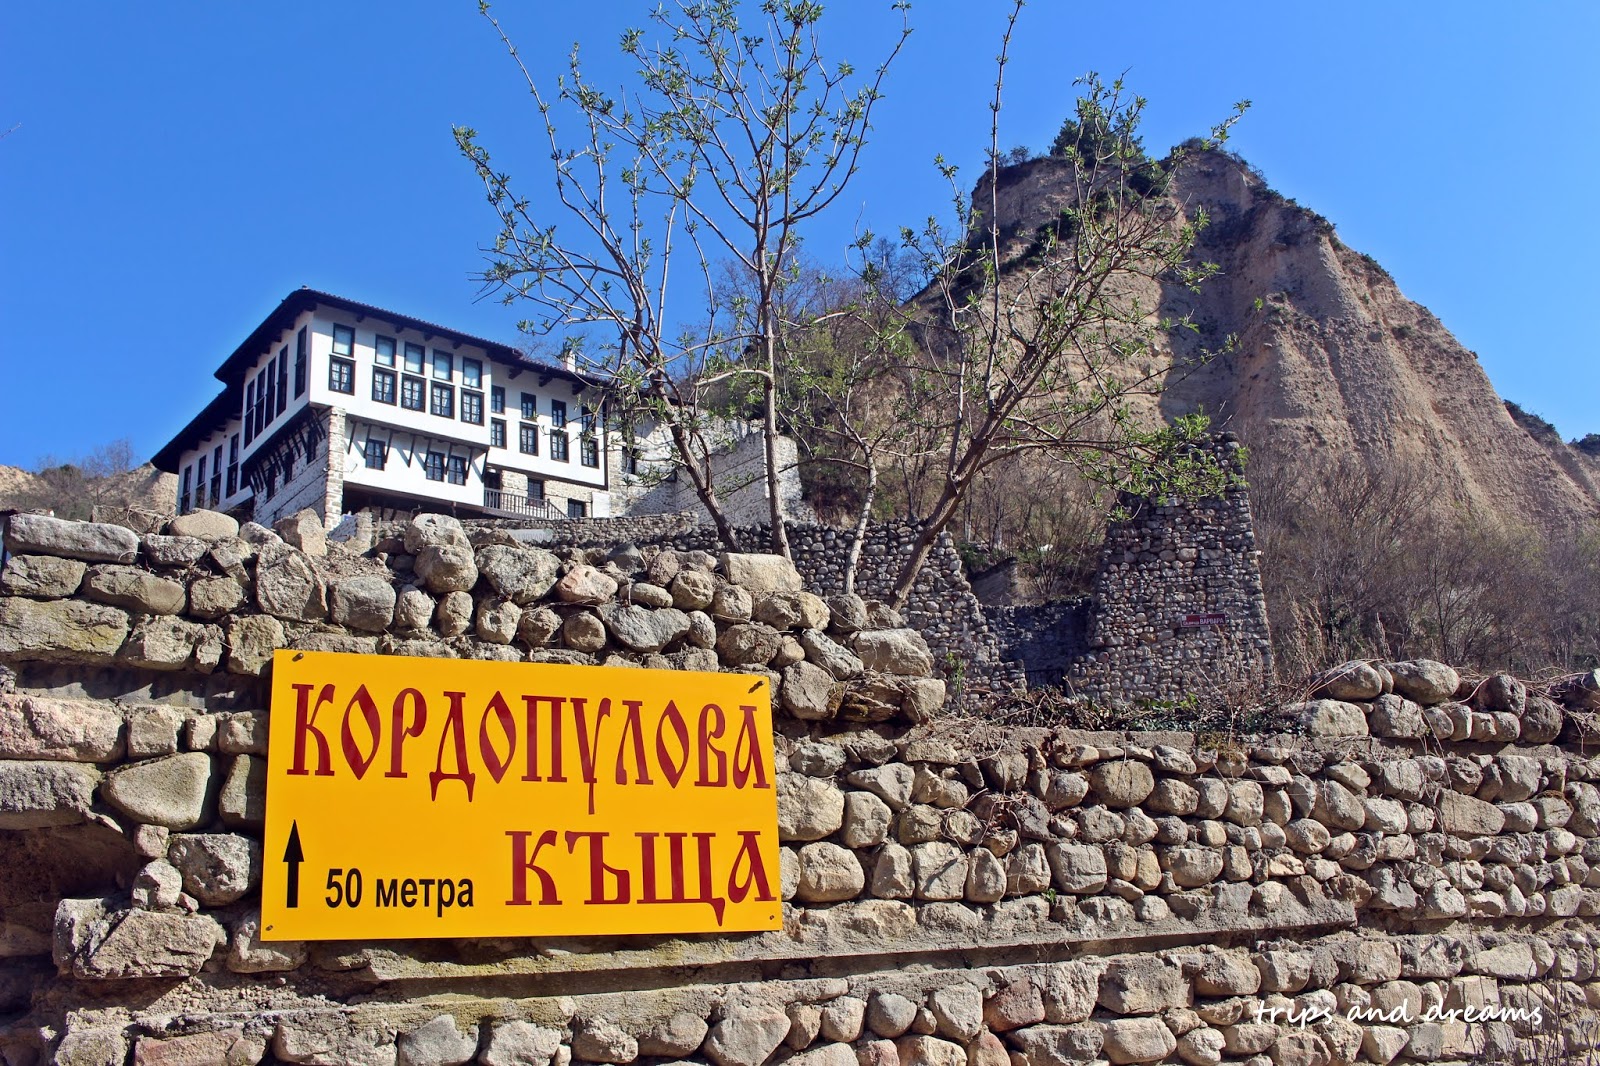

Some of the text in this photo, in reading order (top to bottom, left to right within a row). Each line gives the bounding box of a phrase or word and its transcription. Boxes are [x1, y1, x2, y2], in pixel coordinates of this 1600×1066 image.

[286, 683, 771, 815] КОРДОПУЛОВА
[325, 867, 474, 918] 50 метра
[505, 829, 777, 927] КЪЩА
